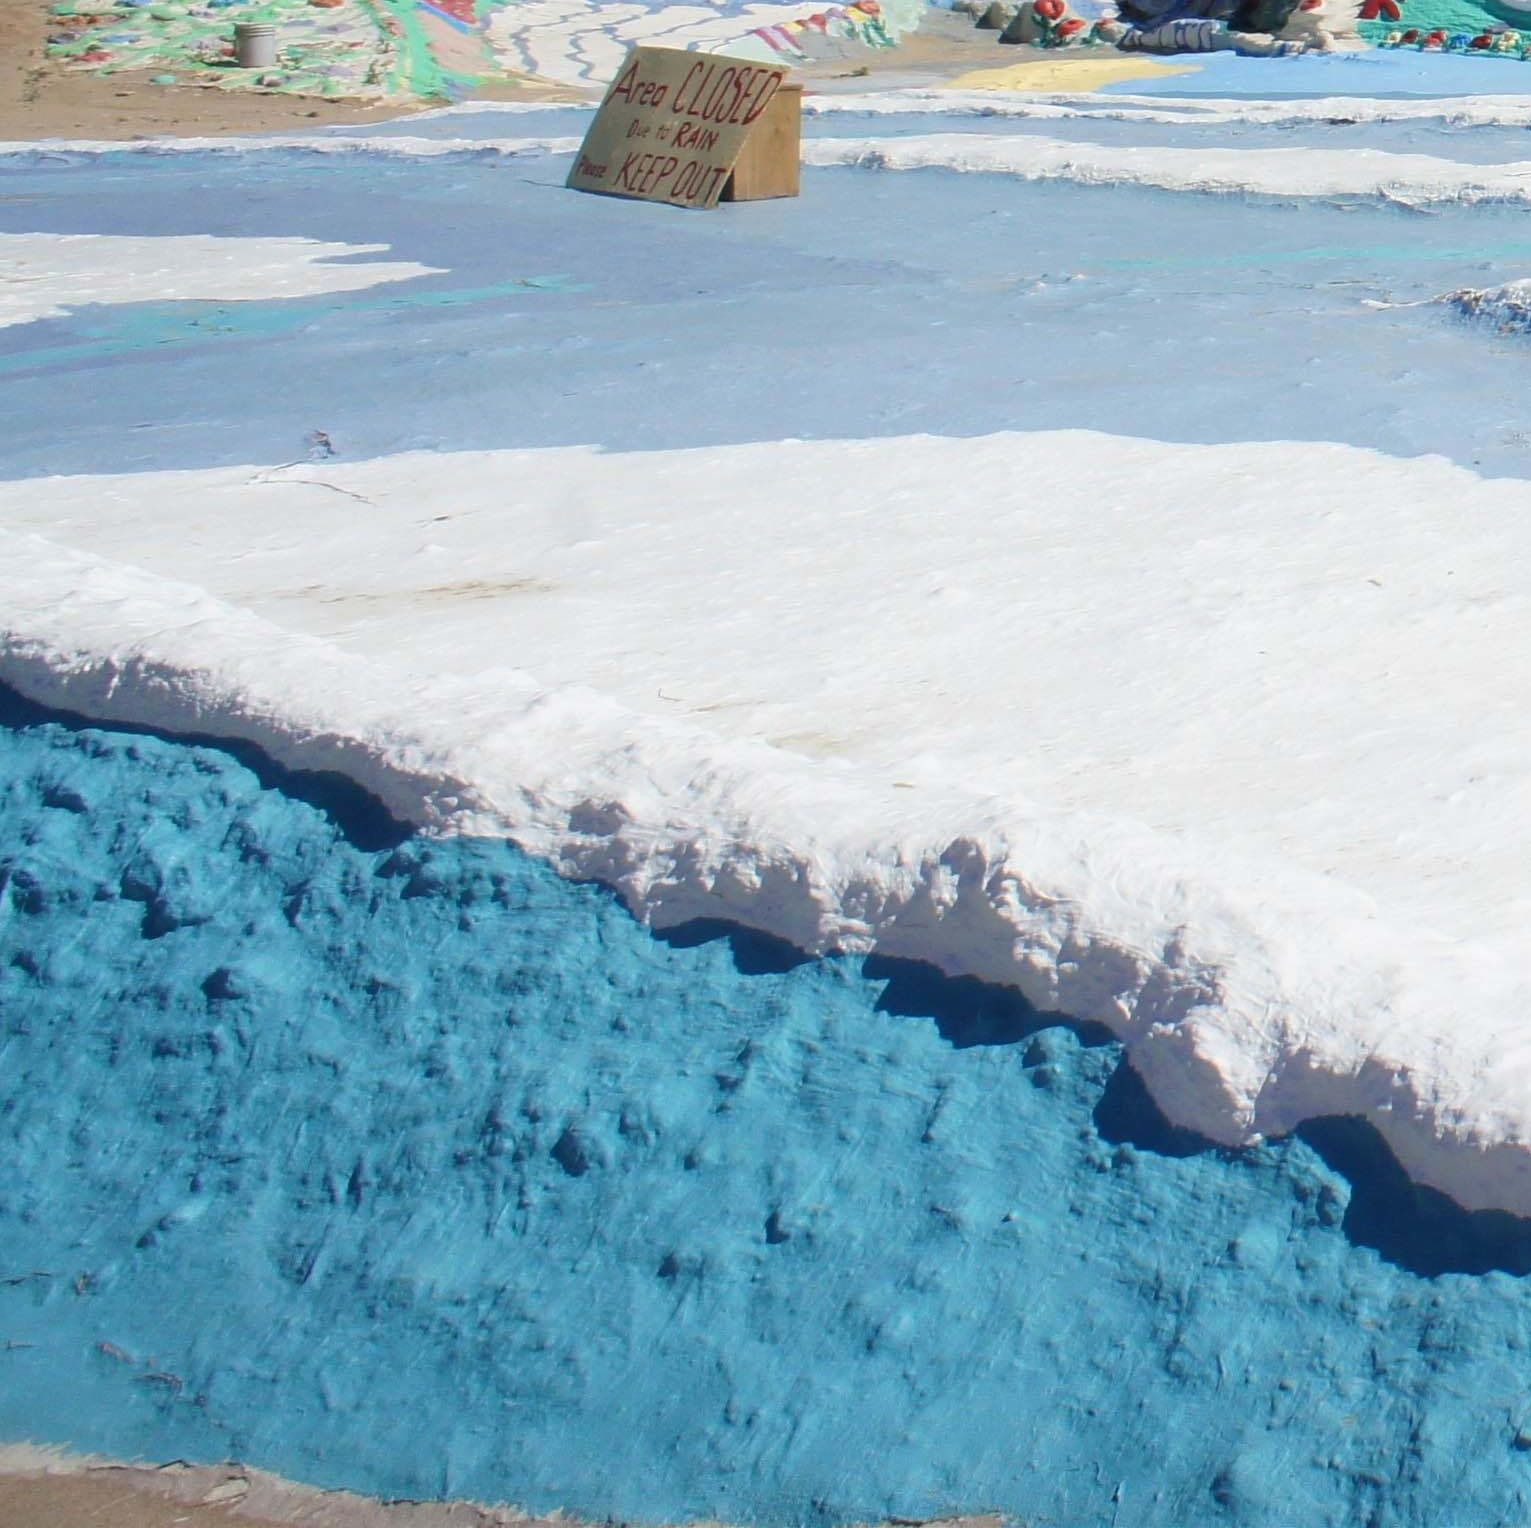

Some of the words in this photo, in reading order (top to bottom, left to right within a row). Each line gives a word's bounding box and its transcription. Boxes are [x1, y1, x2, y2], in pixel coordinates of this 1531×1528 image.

[604, 60, 669, 107] Area
[671, 60, 785, 126] CLOSED
[628, 119, 650, 138] Due
[672, 122, 720, 152] RAIN
[614, 153, 678, 193] KEEP
[671, 161, 729, 201] OUT
